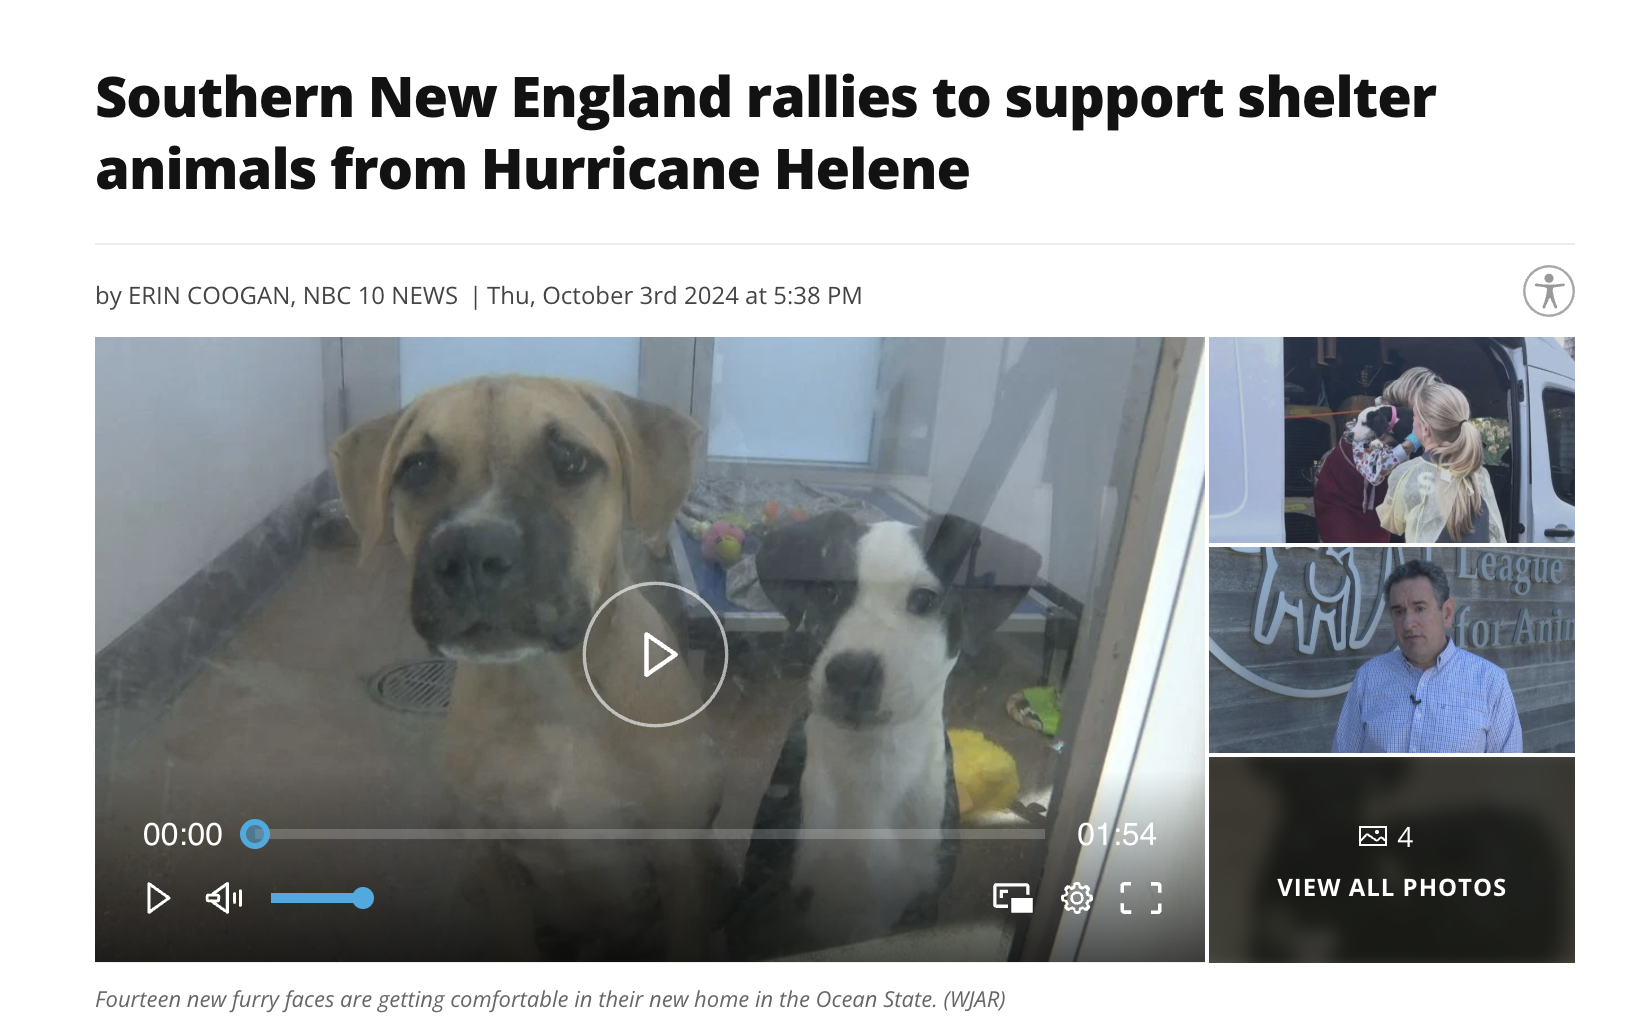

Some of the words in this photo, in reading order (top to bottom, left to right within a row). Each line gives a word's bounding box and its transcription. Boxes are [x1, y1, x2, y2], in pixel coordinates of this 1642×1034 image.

[96, 74, 353, 119] Southern
[371, 76, 498, 119] New
[514, 74, 731, 131] England
[748, 73, 918, 119] rallies
[932, 80, 991, 119] to
[1006, 80, 1224, 131] support
[1238, 74, 1437, 119] shelter
[96, 145, 316, 191] animals
[330, 146, 466, 191] from
[484, 145, 760, 191] Hurricane
[777, 146, 970, 191] Helene
[96, 286, 123, 311] by
[129, 287, 180, 305] ERIN
[187, 286, 296, 308] COOGAN,
[304, 287, 351, 305] NBC
[360, 287, 385, 305] 10
[392, 287, 458, 305] NEWS
[486, 286, 535, 308] Thu,
[543, 286, 634, 305] October
[640, 286, 677, 305] 3rd
[684, 286, 740, 305] 2024
[745, 288, 768, 305] at
[774, 287, 821, 305] 5:38
[828, 287, 862, 305] PM
[1456, 547, 1563, 595] League
[1457, 605, 1503, 648] for
[143, 822, 223, 847] 00:00
[1078, 822, 1157, 846] 01:54
[1397, 826, 1414, 848] 4
[1277, 878, 1341, 897] VIEW
[1348, 878, 1395, 897] ALL
[1404, 878, 1506, 897] PHOTOS
[95, 990, 181, 1008] Fourteen
[186, 994, 227, 1008] new
[230, 990, 280, 1012] furry
[282, 990, 335, 1012] faces
[340, 994, 373, 1008] are
[377, 991, 446, 1013] getting
[450, 990, 569, 1013] comfortable
[574, 991, 592, 1008] in
[598, 990, 645, 1008] their
[649, 994, 690, 1008] new
[694, 990, 750, 1008] home
[755, 991, 773, 1008] in
[779, 990, 810, 1008] the
[816, 990, 877, 1008] Ocean
[883, 990, 936, 1008] State.
[943, 990, 1006, 1012] (WJAR)
